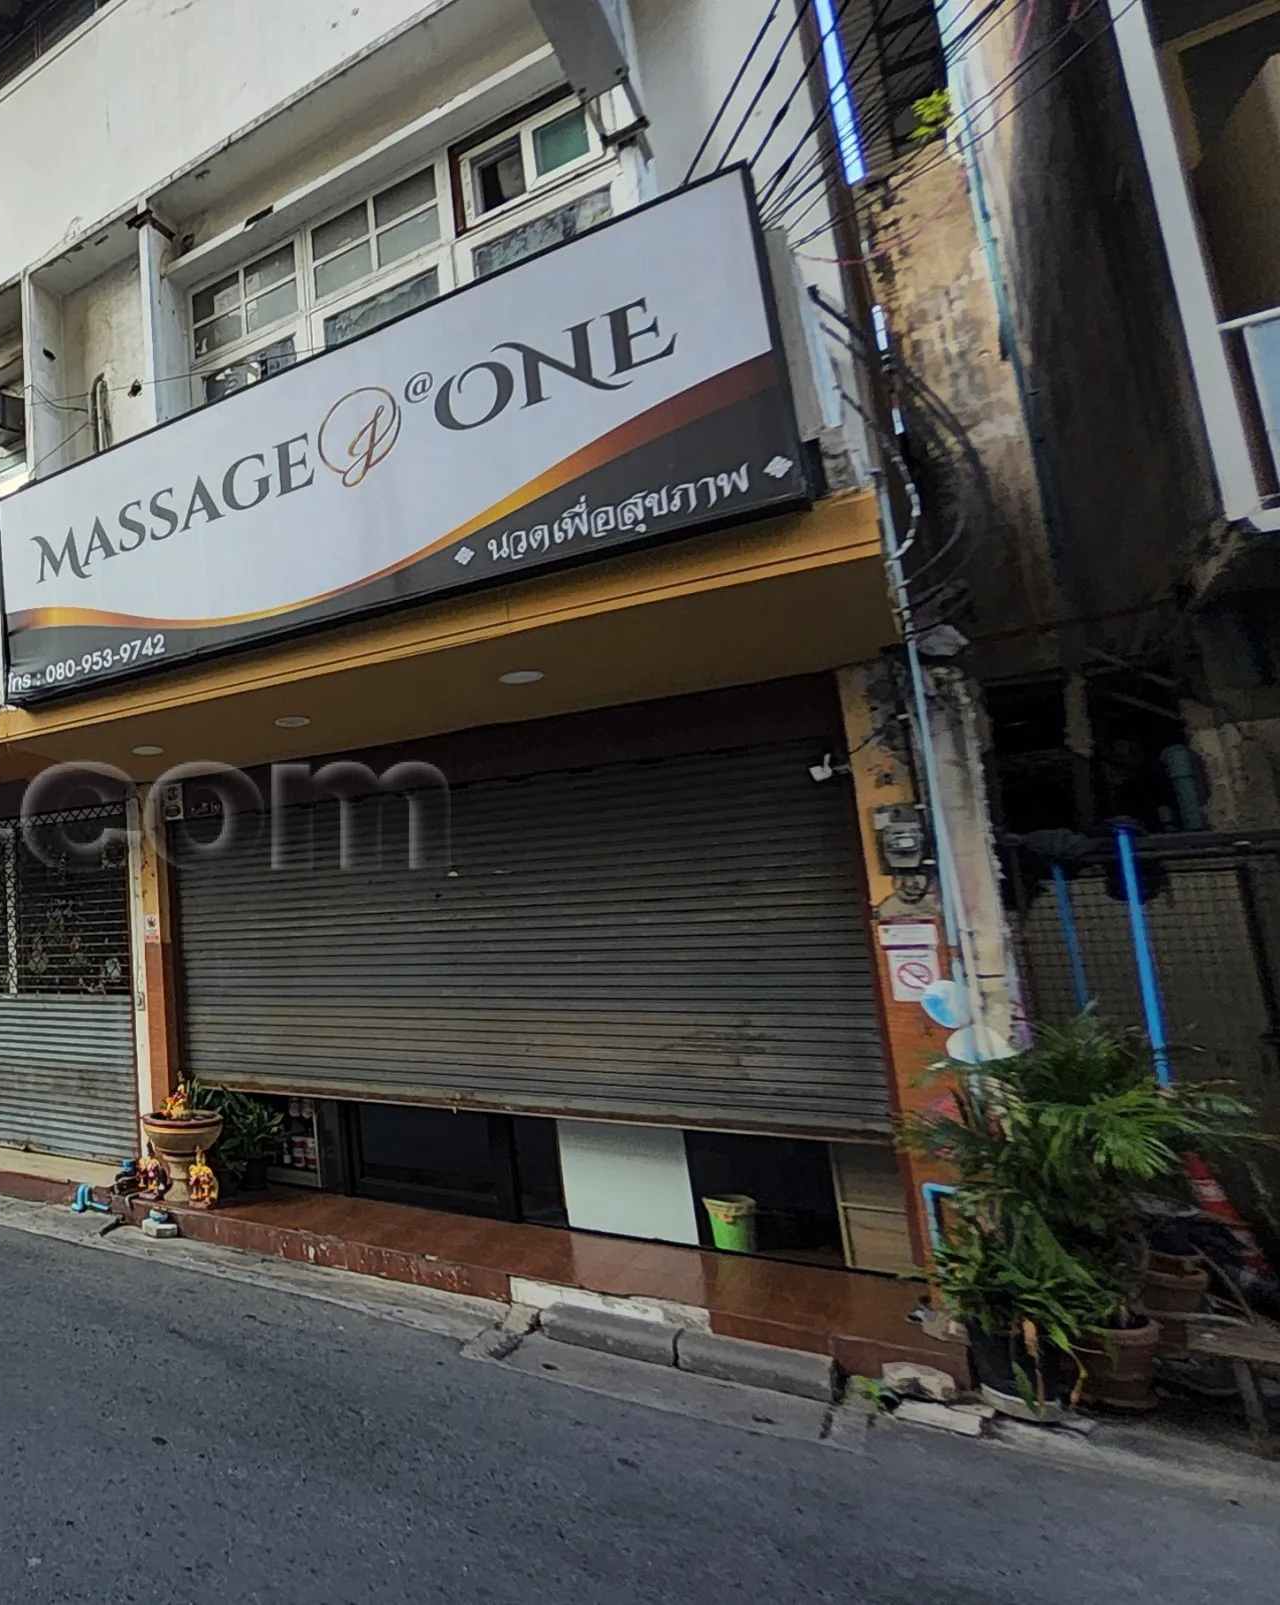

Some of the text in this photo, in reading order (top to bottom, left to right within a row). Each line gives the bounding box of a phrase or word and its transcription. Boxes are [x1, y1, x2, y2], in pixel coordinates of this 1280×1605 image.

[30, 432, 315, 584] MASSAGE
[434, 296, 678, 431] ONE
[487, 463, 750, 561] นวดเพื่อสุขภาพ
[45, 633, 165, 683] 080-953-9742
